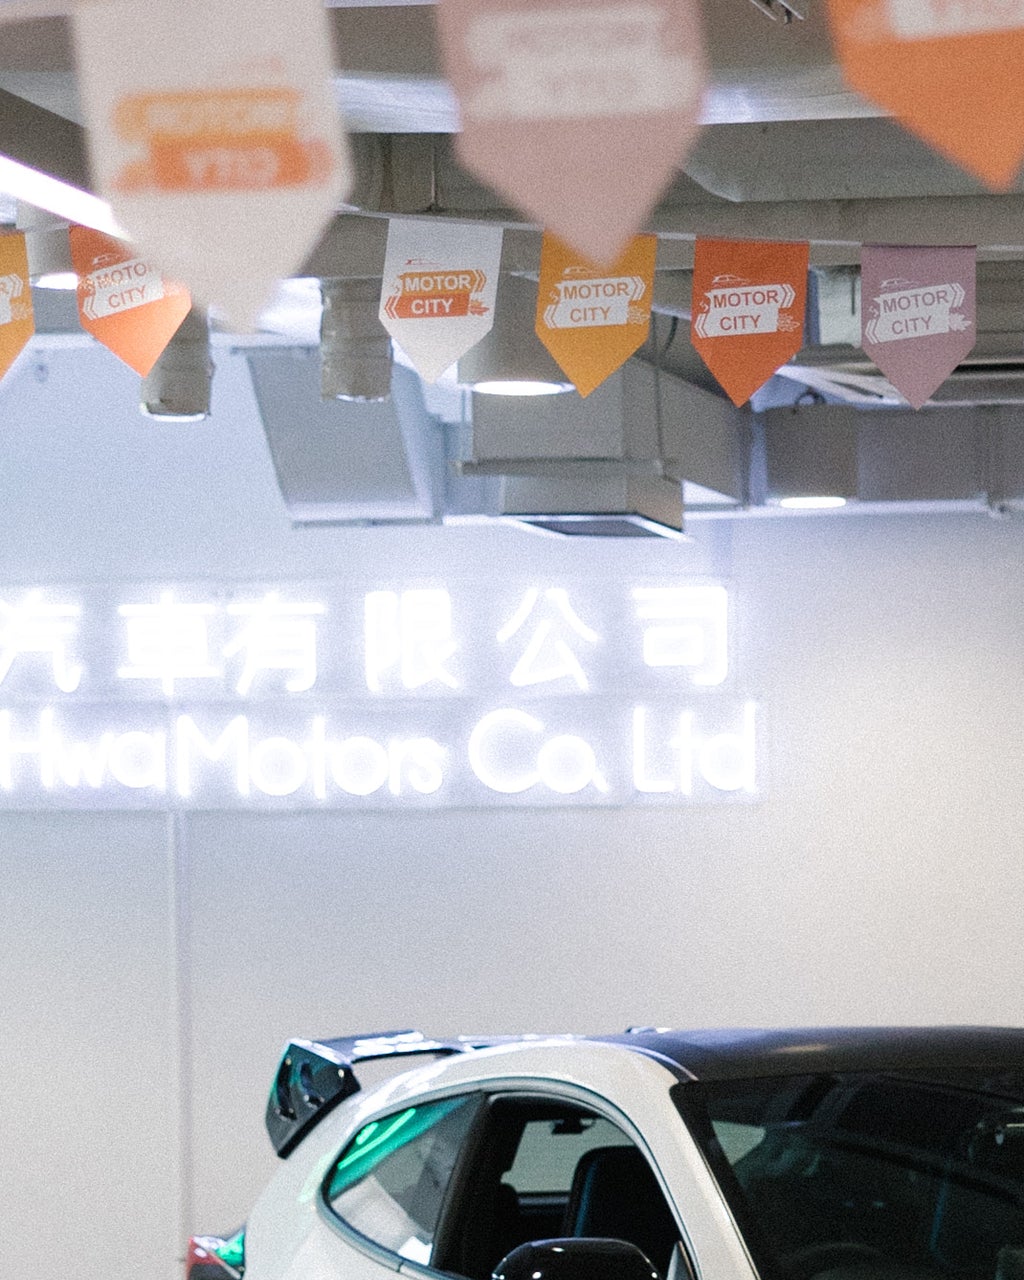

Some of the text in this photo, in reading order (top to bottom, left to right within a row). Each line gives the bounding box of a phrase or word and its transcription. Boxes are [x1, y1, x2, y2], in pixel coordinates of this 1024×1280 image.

[97, 262, 147, 290] MOTO
[405, 274, 471, 292] MOTOR
[108, 285, 147, 309] CITY
[564, 282, 630, 300] MOTOR
[713, 290, 779, 308] MOTOR
[411, 299, 454, 314] CITY
[883, 290, 949, 313] MOTOR
[570, 306, 611, 323] CITY
[720, 315, 761, 331] CITY
[892, 315, 932, 335] CITY
[176, 714, 447, 798] Motors
[632, 702, 758, 793] Ltd
